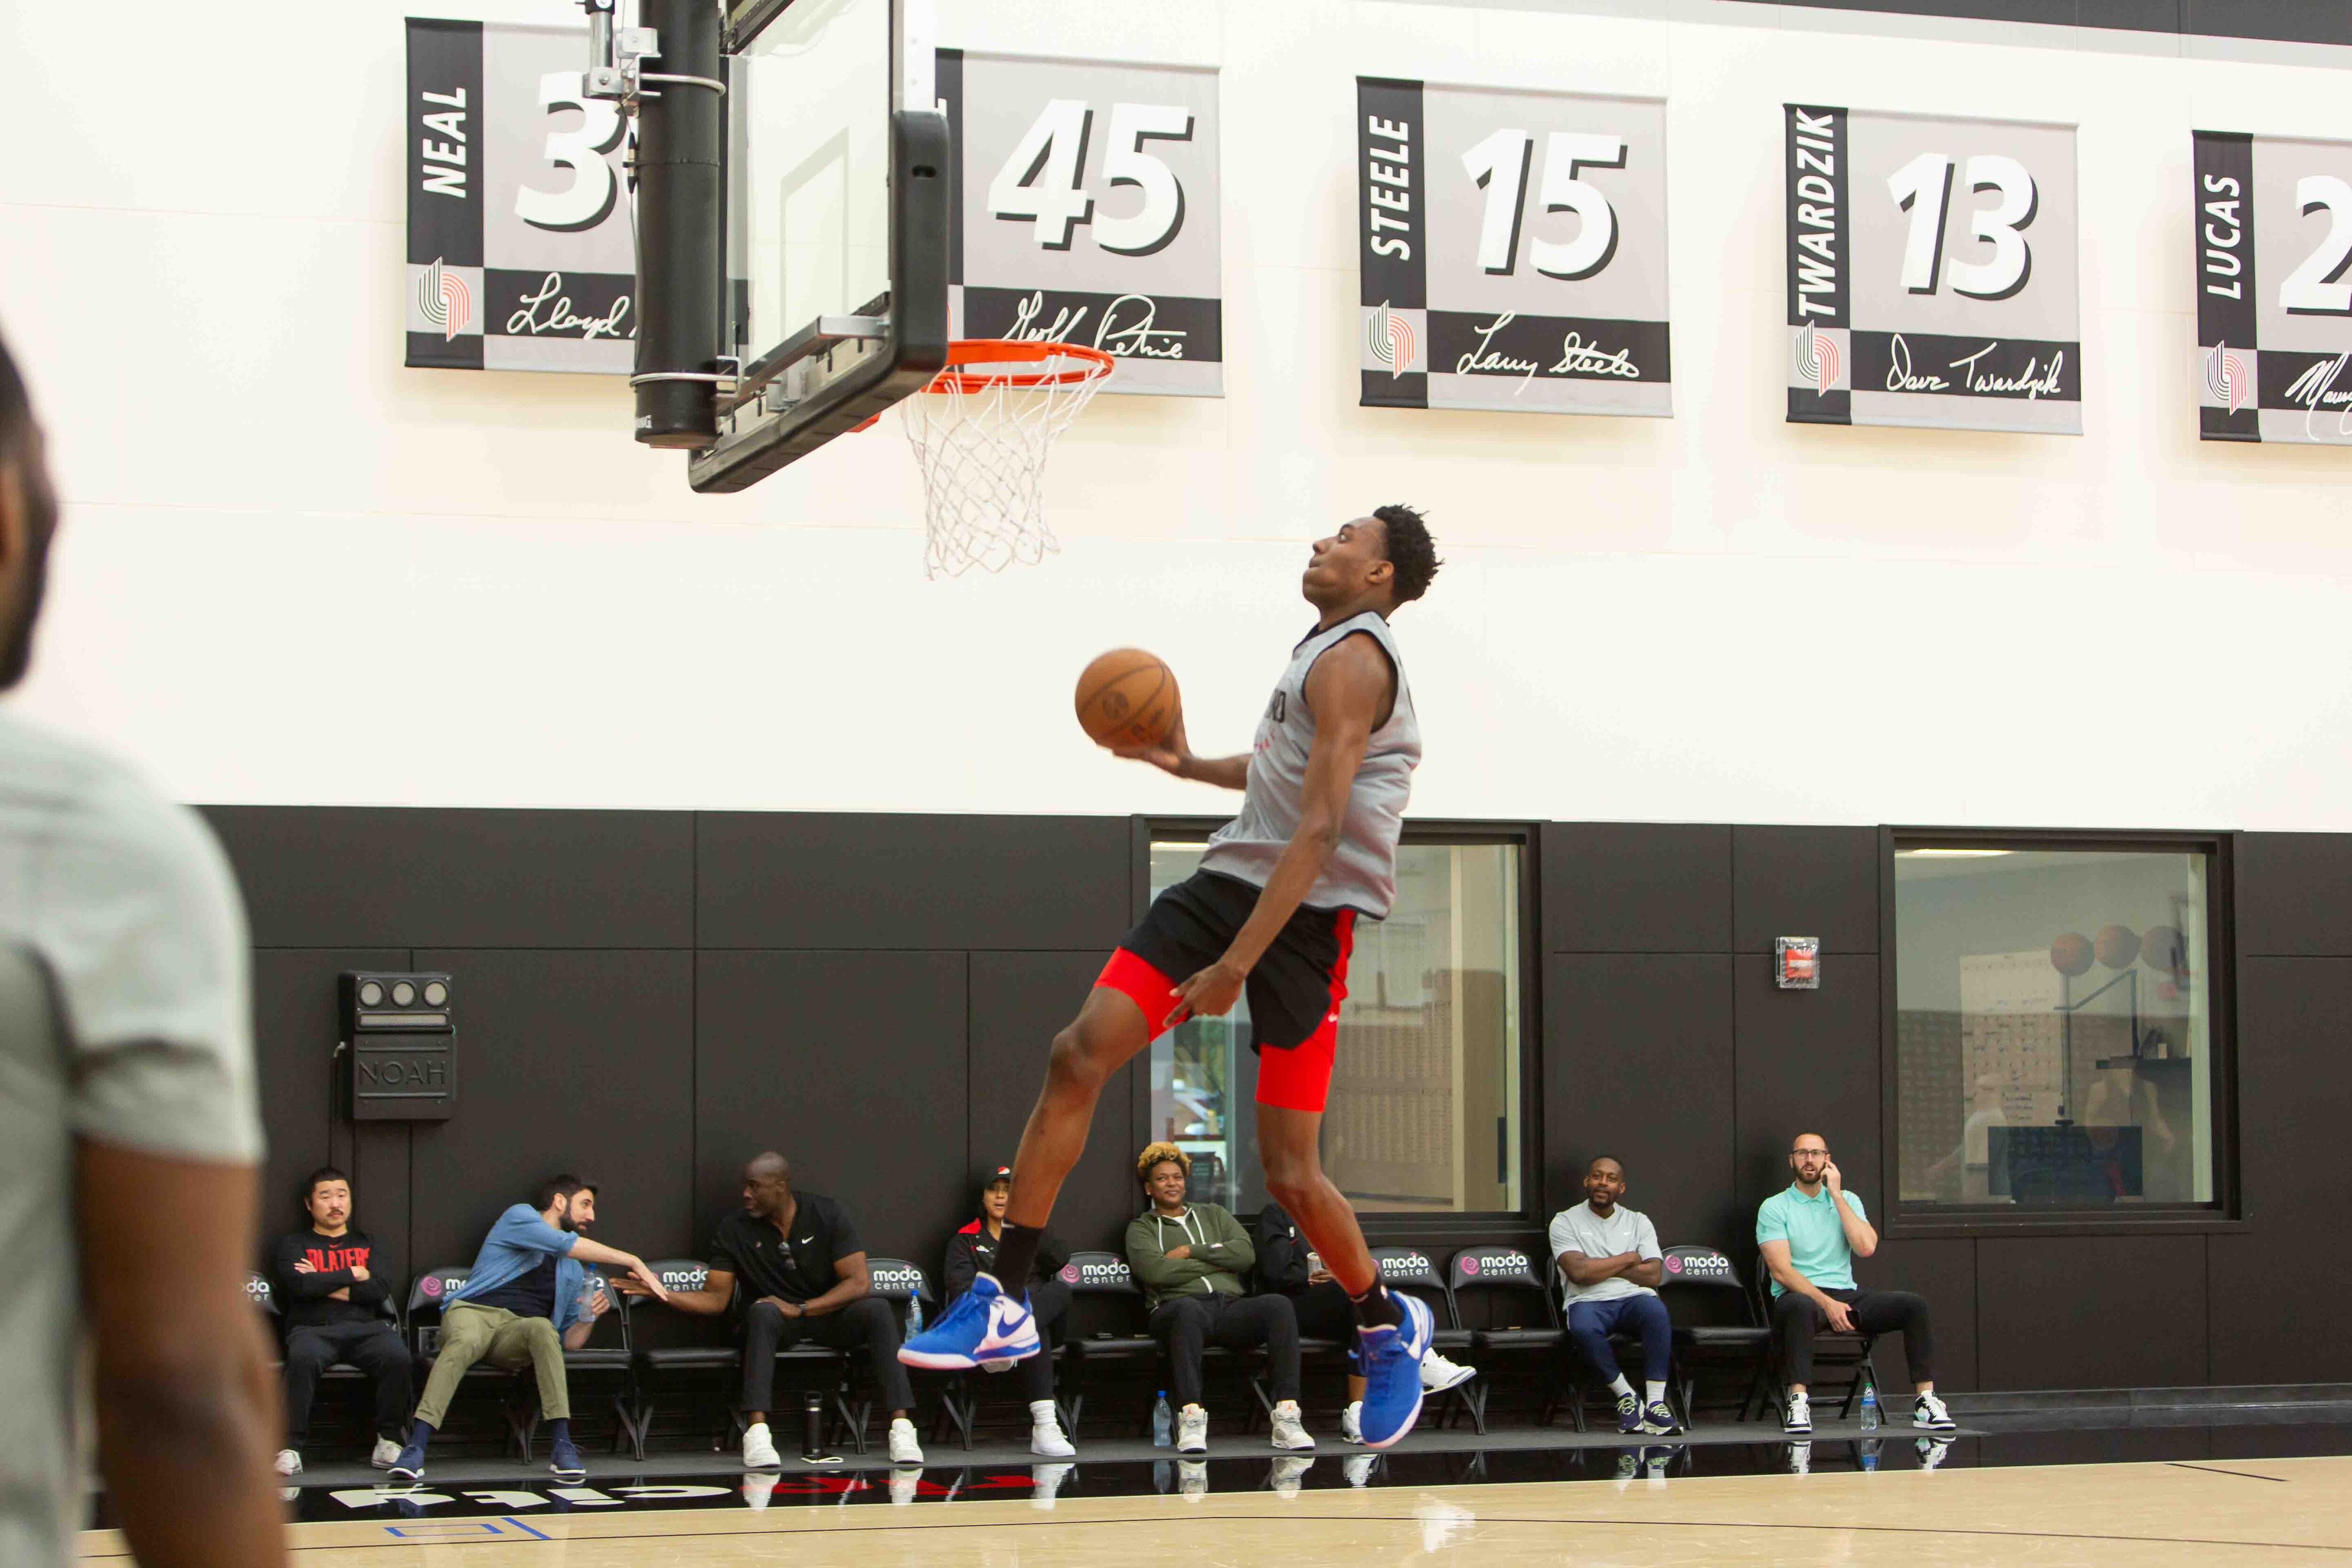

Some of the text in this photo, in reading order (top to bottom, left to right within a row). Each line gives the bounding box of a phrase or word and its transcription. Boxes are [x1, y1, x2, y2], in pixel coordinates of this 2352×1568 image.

[422, 87, 467, 198] NEAL
[514, 72, 639, 232] 3
[987, 98, 1195, 257] 45
[1369, 115, 1410, 261] STEELE
[1461, 128, 1628, 281] 15
[1796, 107, 1836, 316] TWARDZIK
[1887, 152, 2038, 301] 13
[2204, 174, 2241, 299] LUCAS
[507, 272, 629, 340] Lloyd
[1093, 294, 1187, 359] Petrie
[359, 1060, 445, 1085] NOAH
[1082, 1261, 1130, 1275] moda
[1383, 1254, 1429, 1269] moda
[1481, 1253, 1528, 1267] moda
[1483, 1266, 1528, 1275] center
[1684, 1255, 1729, 1267] moda
[874, 1267, 922, 1281] moda
[1083, 1275, 1130, 1284] center
[1384, 1268, 1429, 1277] center
[664, 1283, 705, 1291] cente
[875, 1281, 922, 1290] center
[328, 1485, 733, 1508] city
